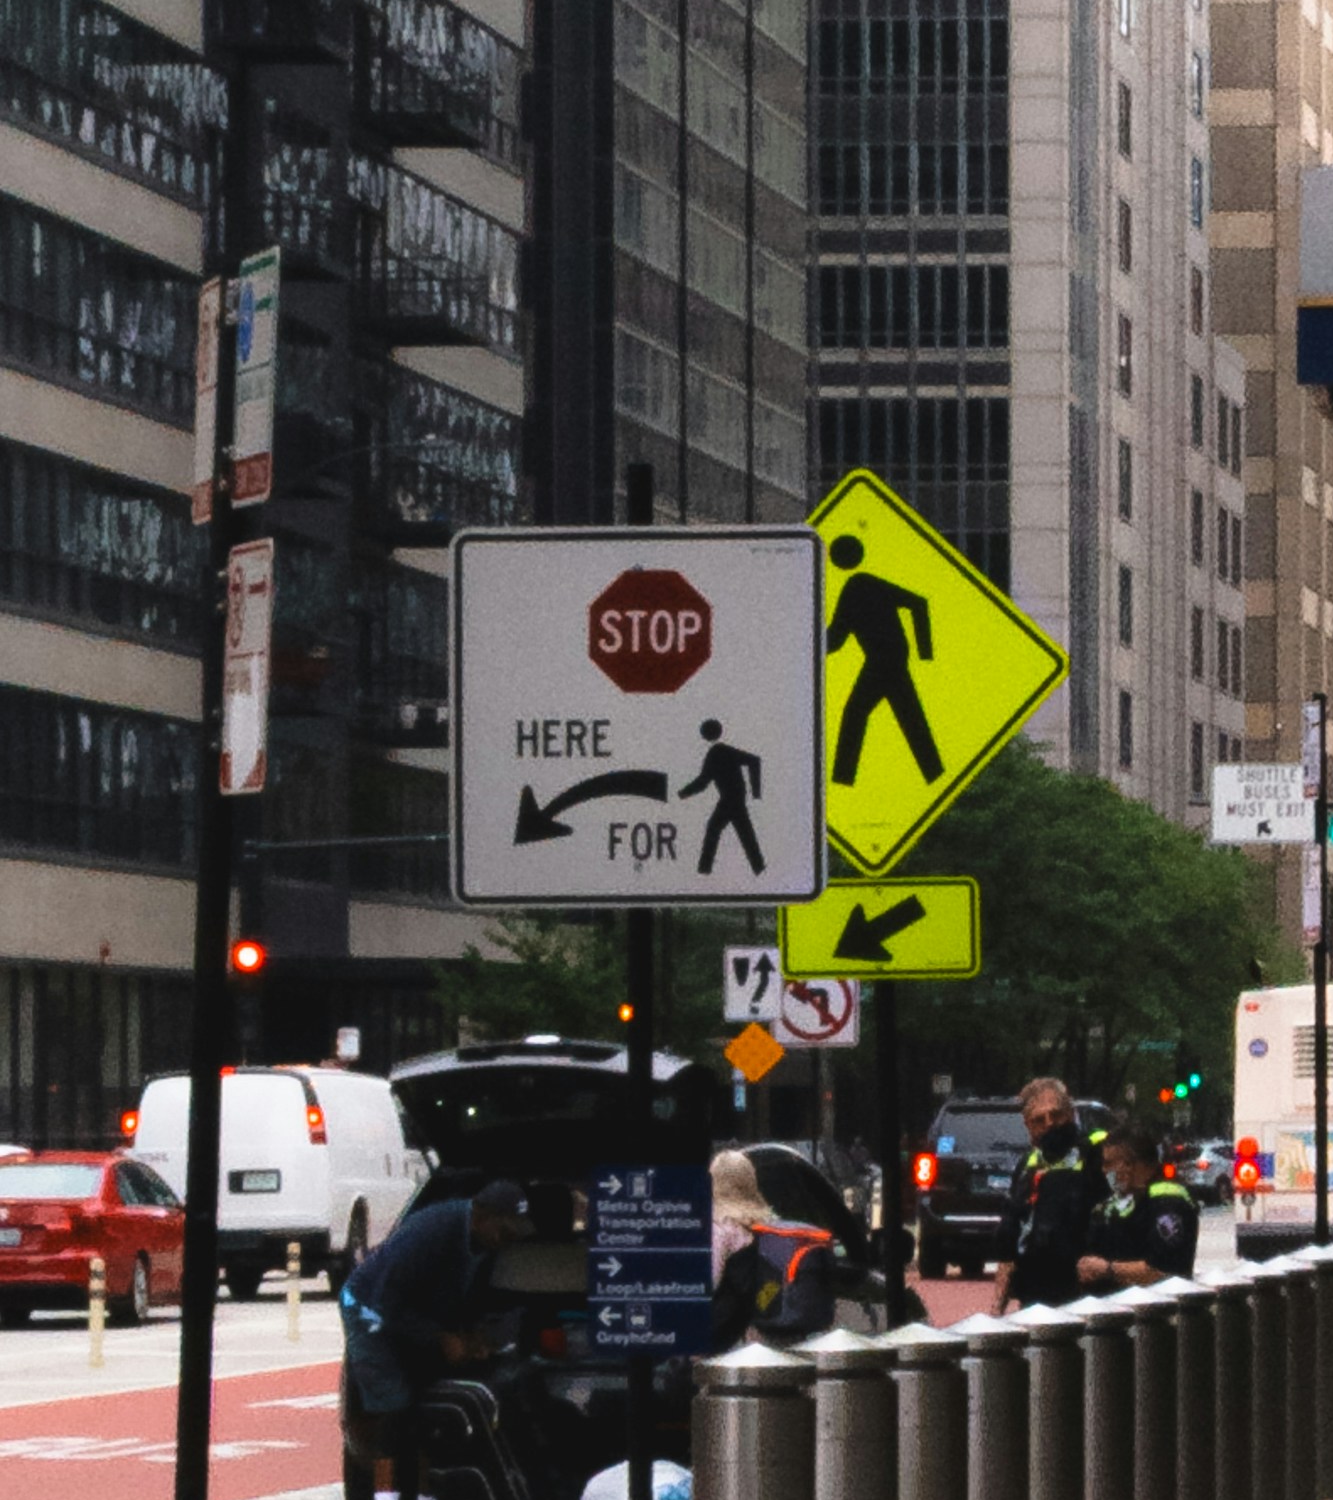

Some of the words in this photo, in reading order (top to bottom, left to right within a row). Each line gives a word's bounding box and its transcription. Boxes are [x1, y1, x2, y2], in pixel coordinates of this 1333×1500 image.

[598, 608, 702, 654] STOP
[515, 718, 613, 759] HERE
[1235, 767, 1298, 784] SHUTTLE
[1243, 785, 1291, 801] BUSES
[1226, 801, 1265, 817] MUST
[1275, 801, 1307, 817] EXIT
[607, 821, 678, 861] FOR
[598, 1200, 637, 1213] Metra
[642, 1200, 692, 1216] Ogilvie
[600, 1216, 701, 1230] Transportation
[598, 1232, 644, 1245] Center
[597, 1282, 705, 1298] Loop/Lakefront
[596, 1331, 676, 1347] Greyhound
